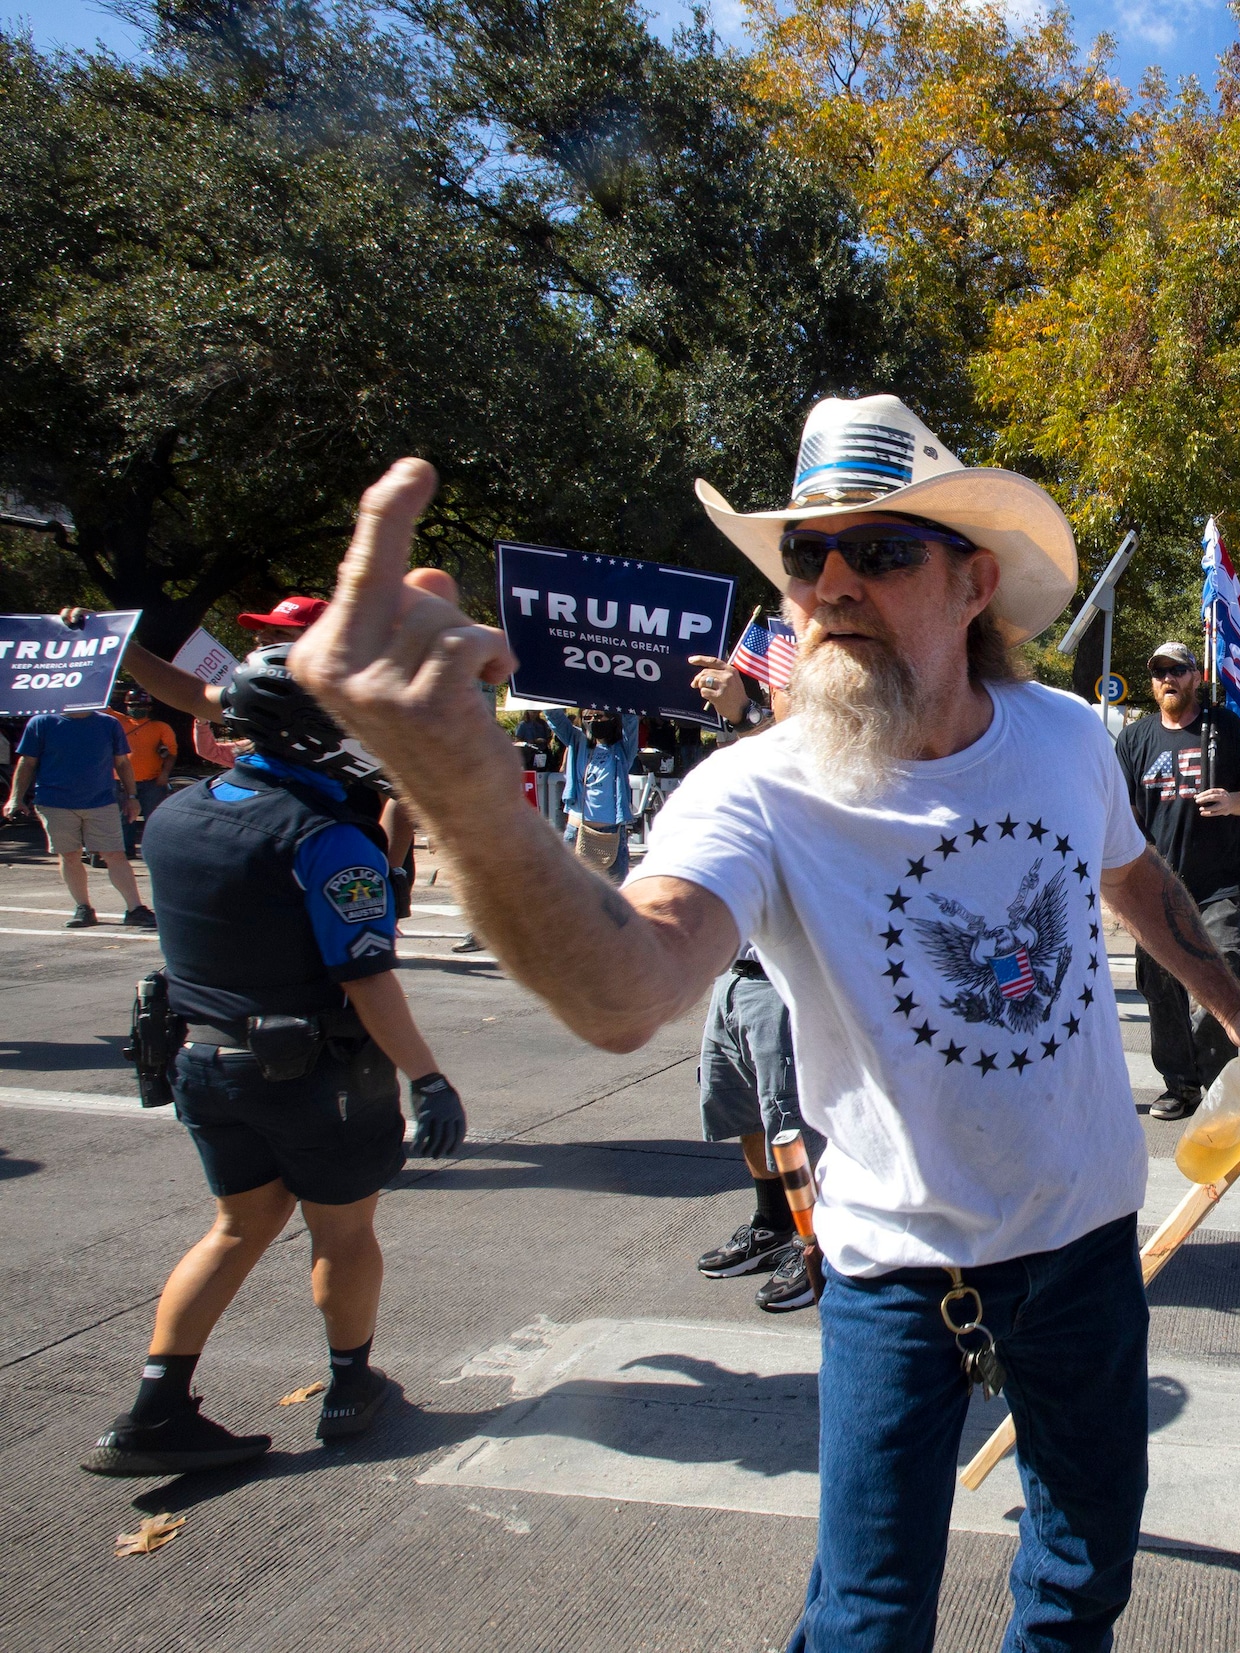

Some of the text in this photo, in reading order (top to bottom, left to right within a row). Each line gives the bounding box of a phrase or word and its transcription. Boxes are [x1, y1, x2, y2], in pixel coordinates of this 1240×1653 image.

[511, 586, 713, 640] TRUMP
[0, 635, 120, 659] TRUMP
[548, 627, 670, 654] KEEP AMERICA GREAT!
[33, 662, 68, 670] AMERICA
[68, 660, 94, 669] GREAT!
[193, 648, 227, 680] men
[562, 645, 662, 682] 2020
[11, 671, 83, 690] 2020
[1104, 679, 1119, 697] B
[1143, 747, 1202, 802] 45
[329, 869, 381, 892] POLICE
